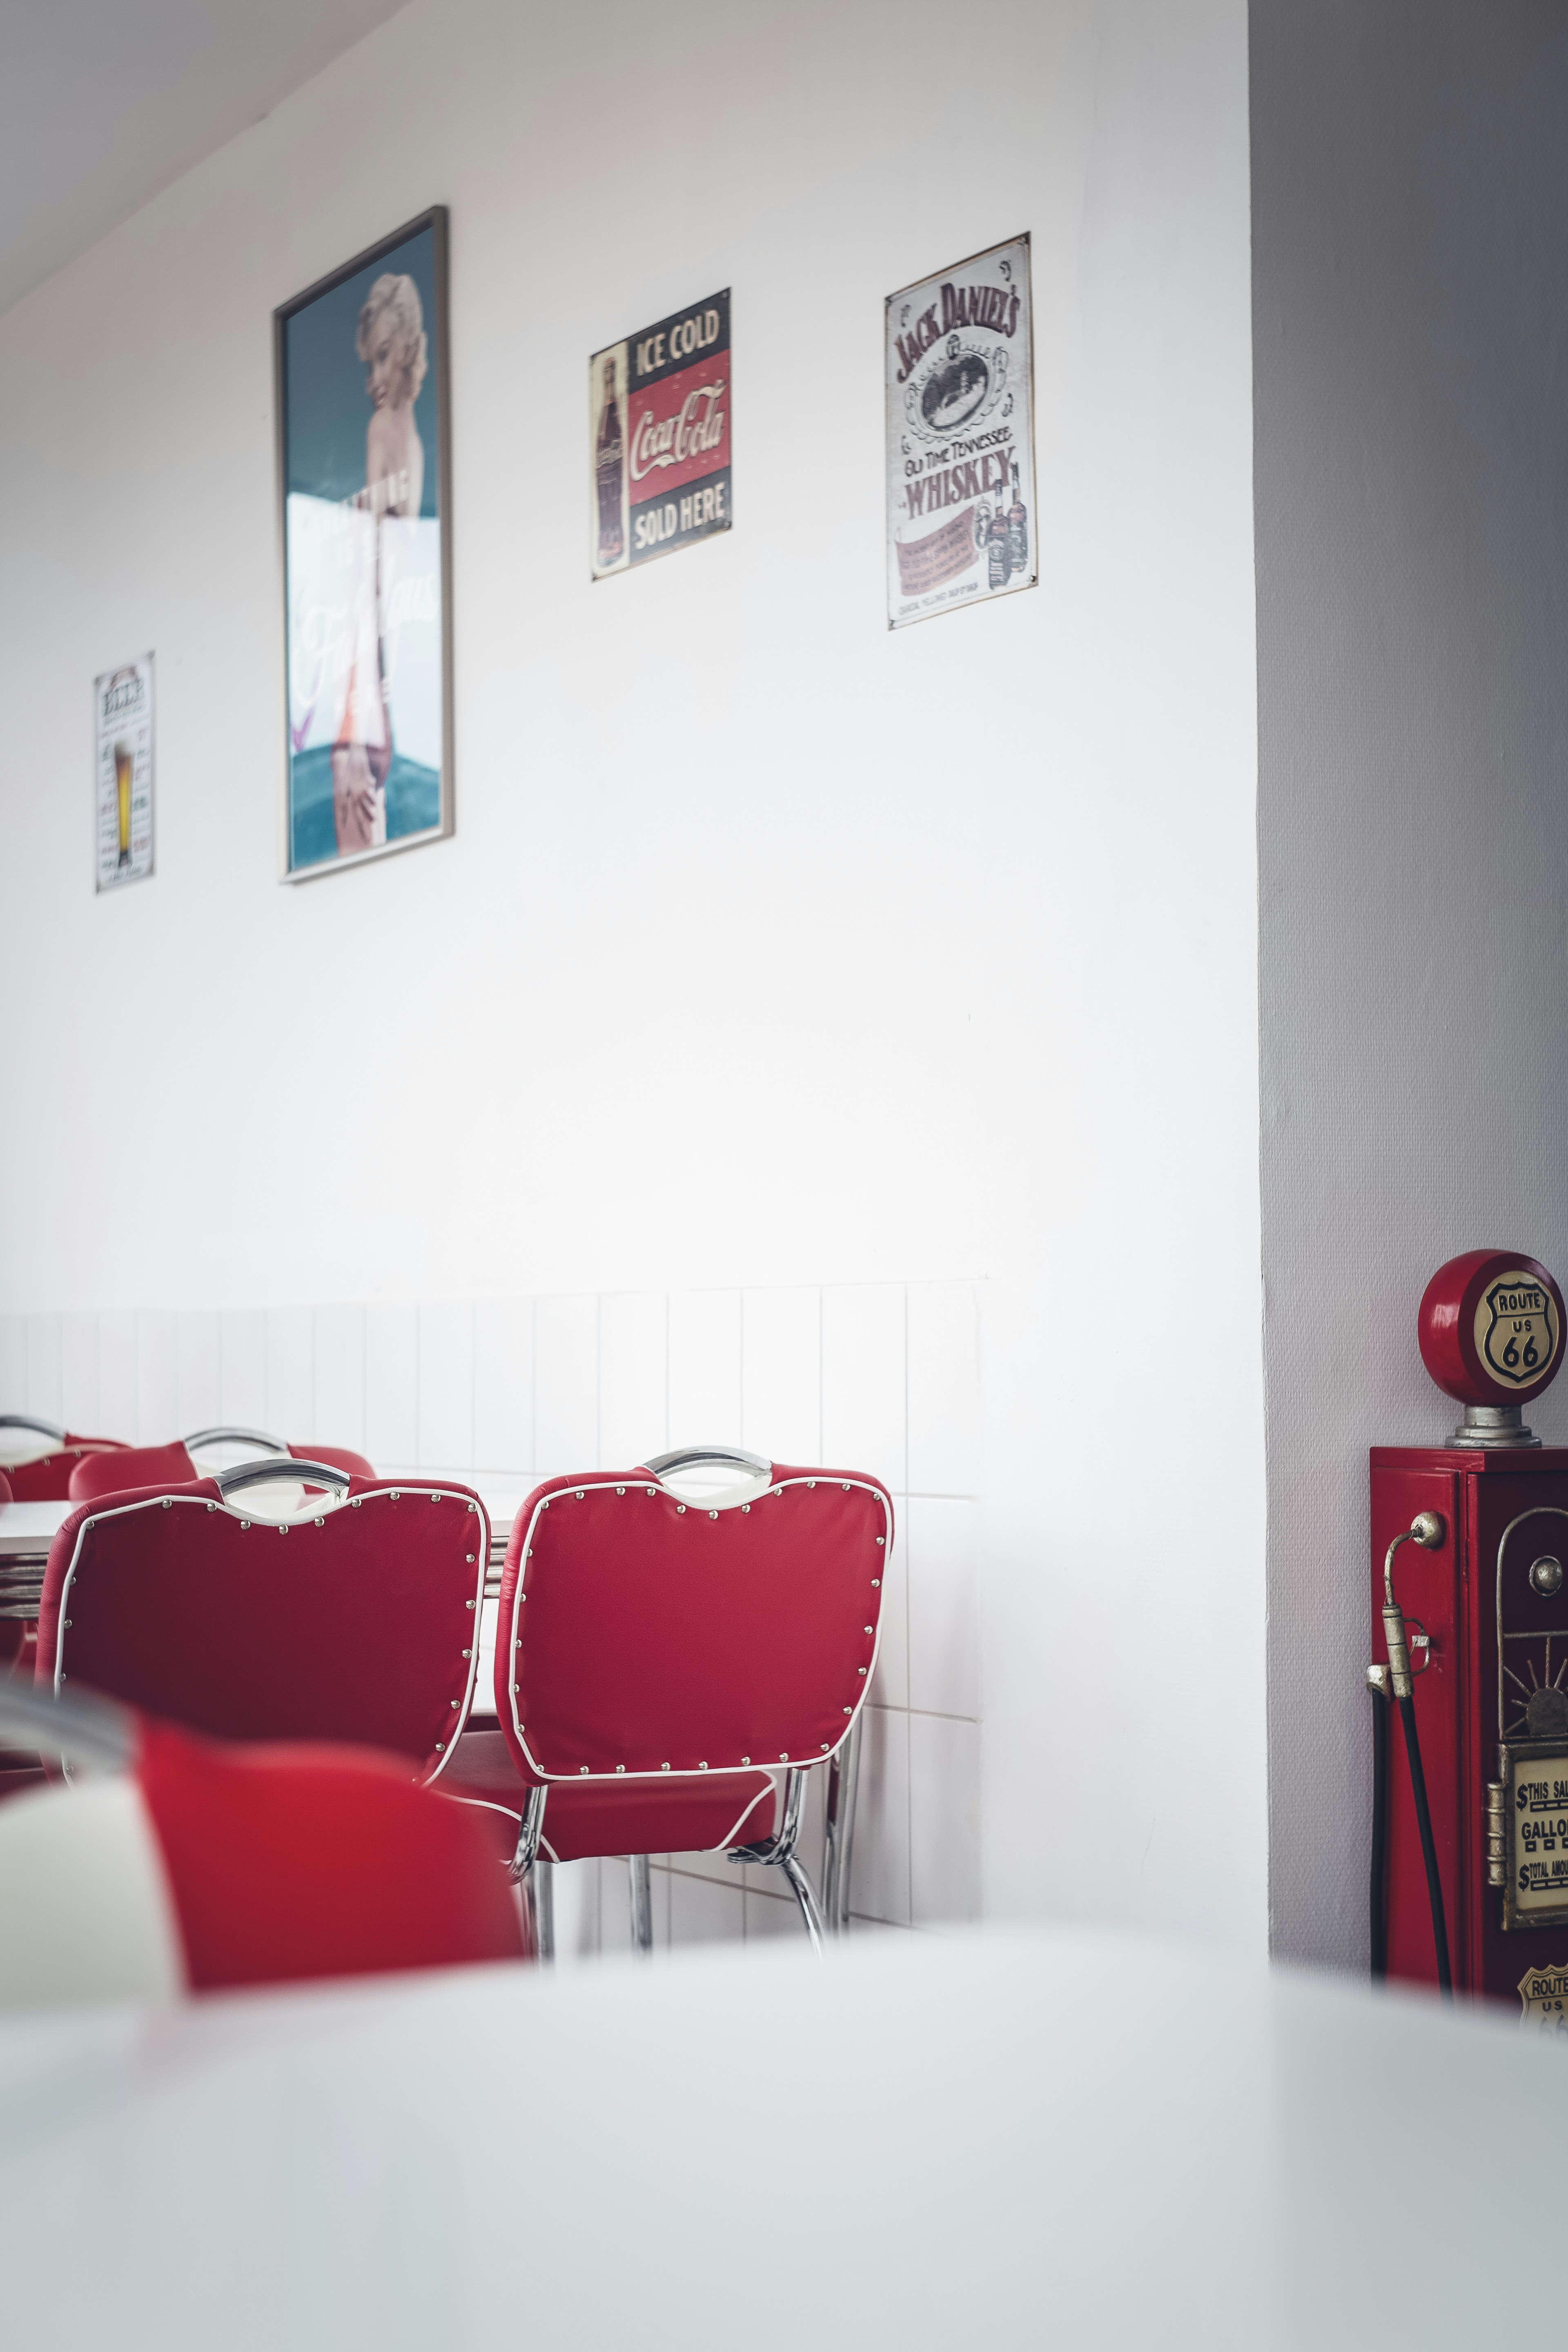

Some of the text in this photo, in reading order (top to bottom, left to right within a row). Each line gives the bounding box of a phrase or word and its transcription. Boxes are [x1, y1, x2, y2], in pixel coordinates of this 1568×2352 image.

[636, 309, 720, 376] ICE COLD
[894, 303, 942, 383] JACK
[940, 283, 1020, 338] DANIEL'S
[925, 448, 950, 468] TIME
[904, 445, 1016, 520] WHISKEY
[635, 482, 725, 549] SOLD HERE
[1498, 1292, 1540, 1311] ROUTE
[1512, 1320, 1532, 1332] US
[1502, 1336, 1539, 1368] 66
[1521, 1819, 1568, 1840] GALLO
[1532, 1976, 1568, 1996] ROUTE
[1542, 2000, 1563, 2012] US
